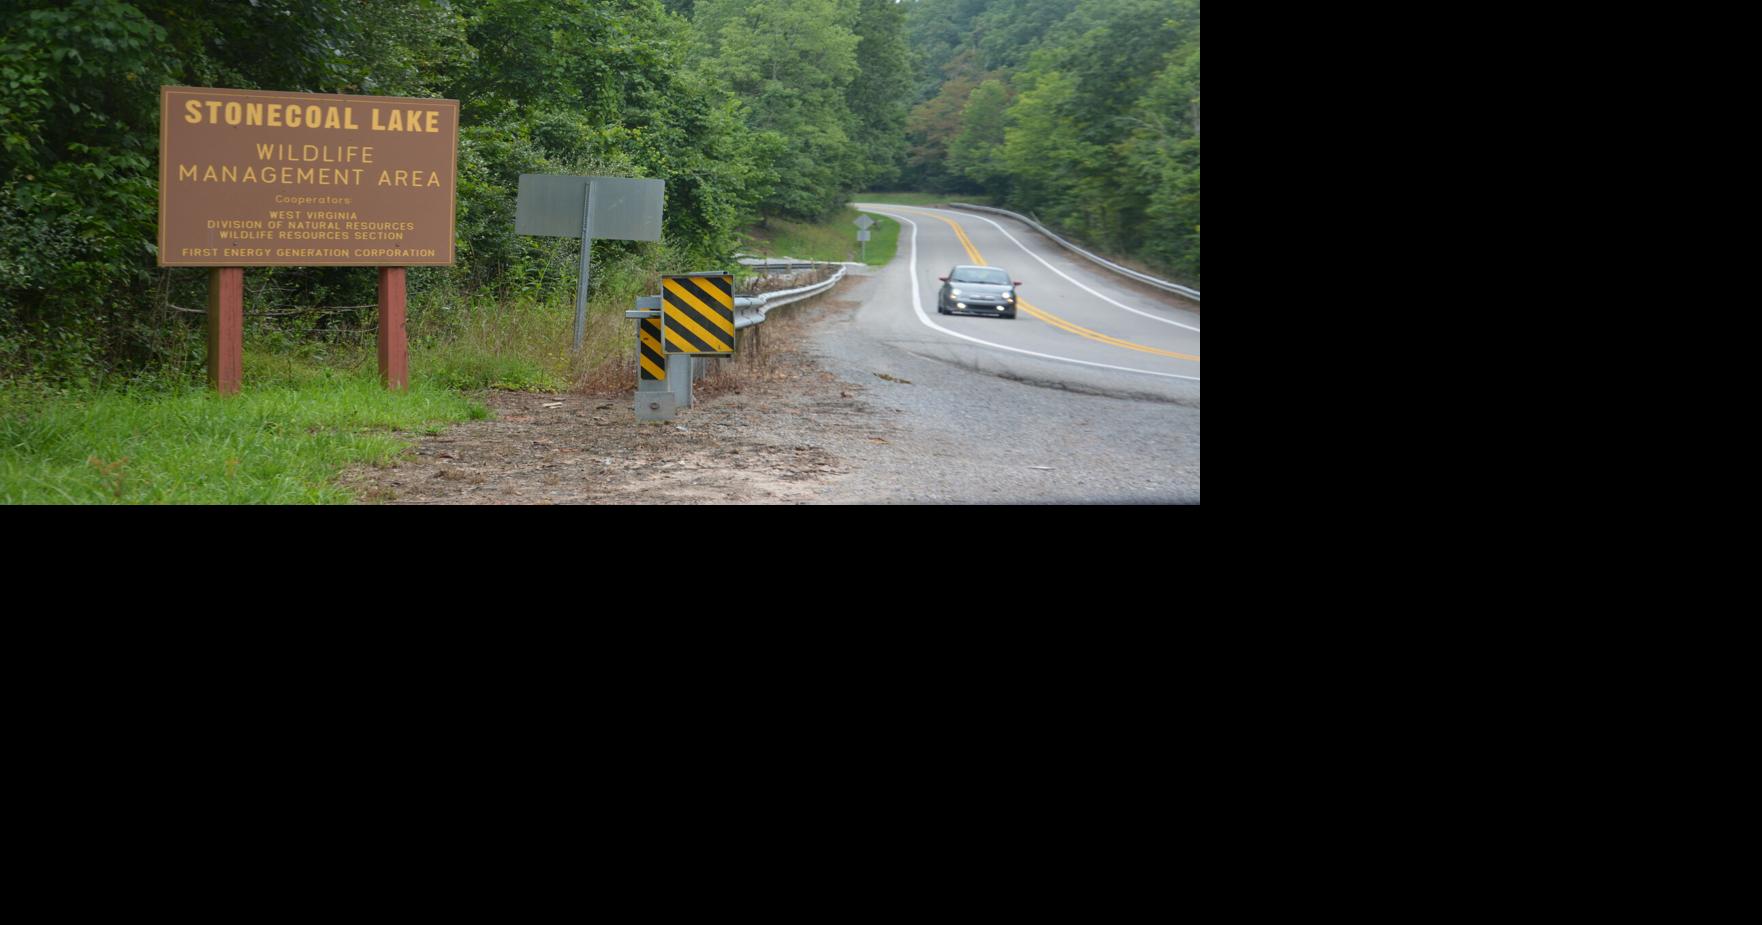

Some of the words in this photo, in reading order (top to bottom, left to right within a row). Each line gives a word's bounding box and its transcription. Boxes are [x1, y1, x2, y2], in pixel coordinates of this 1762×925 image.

[184, 99, 359, 130] STONECOAL
[371, 107, 440, 133] LAKE
[256, 143, 374, 163] WILDLIFE
[178, 164, 364, 186] MANAGEMENT
[377, 170, 441, 188] AREA
[269, 210, 302, 220] WEST
[306, 211, 358, 221] VIRGINIA
[207, 219, 263, 230] DIVISION
[267, 221, 284, 231] OF
[288, 221, 341, 231] NATURAL
[345, 222, 415, 231] RESOURCES
[219, 230, 274, 240] WILDLIFE
[278, 231, 350, 241] RESOURCES
[354, 231, 404, 241] SECTION
[182, 247, 218, 258] FIRST
[223, 248, 272, 258] ENERGY
[276, 248, 350, 259] GENERATION
[354, 248, 436, 259] CORPORATION
